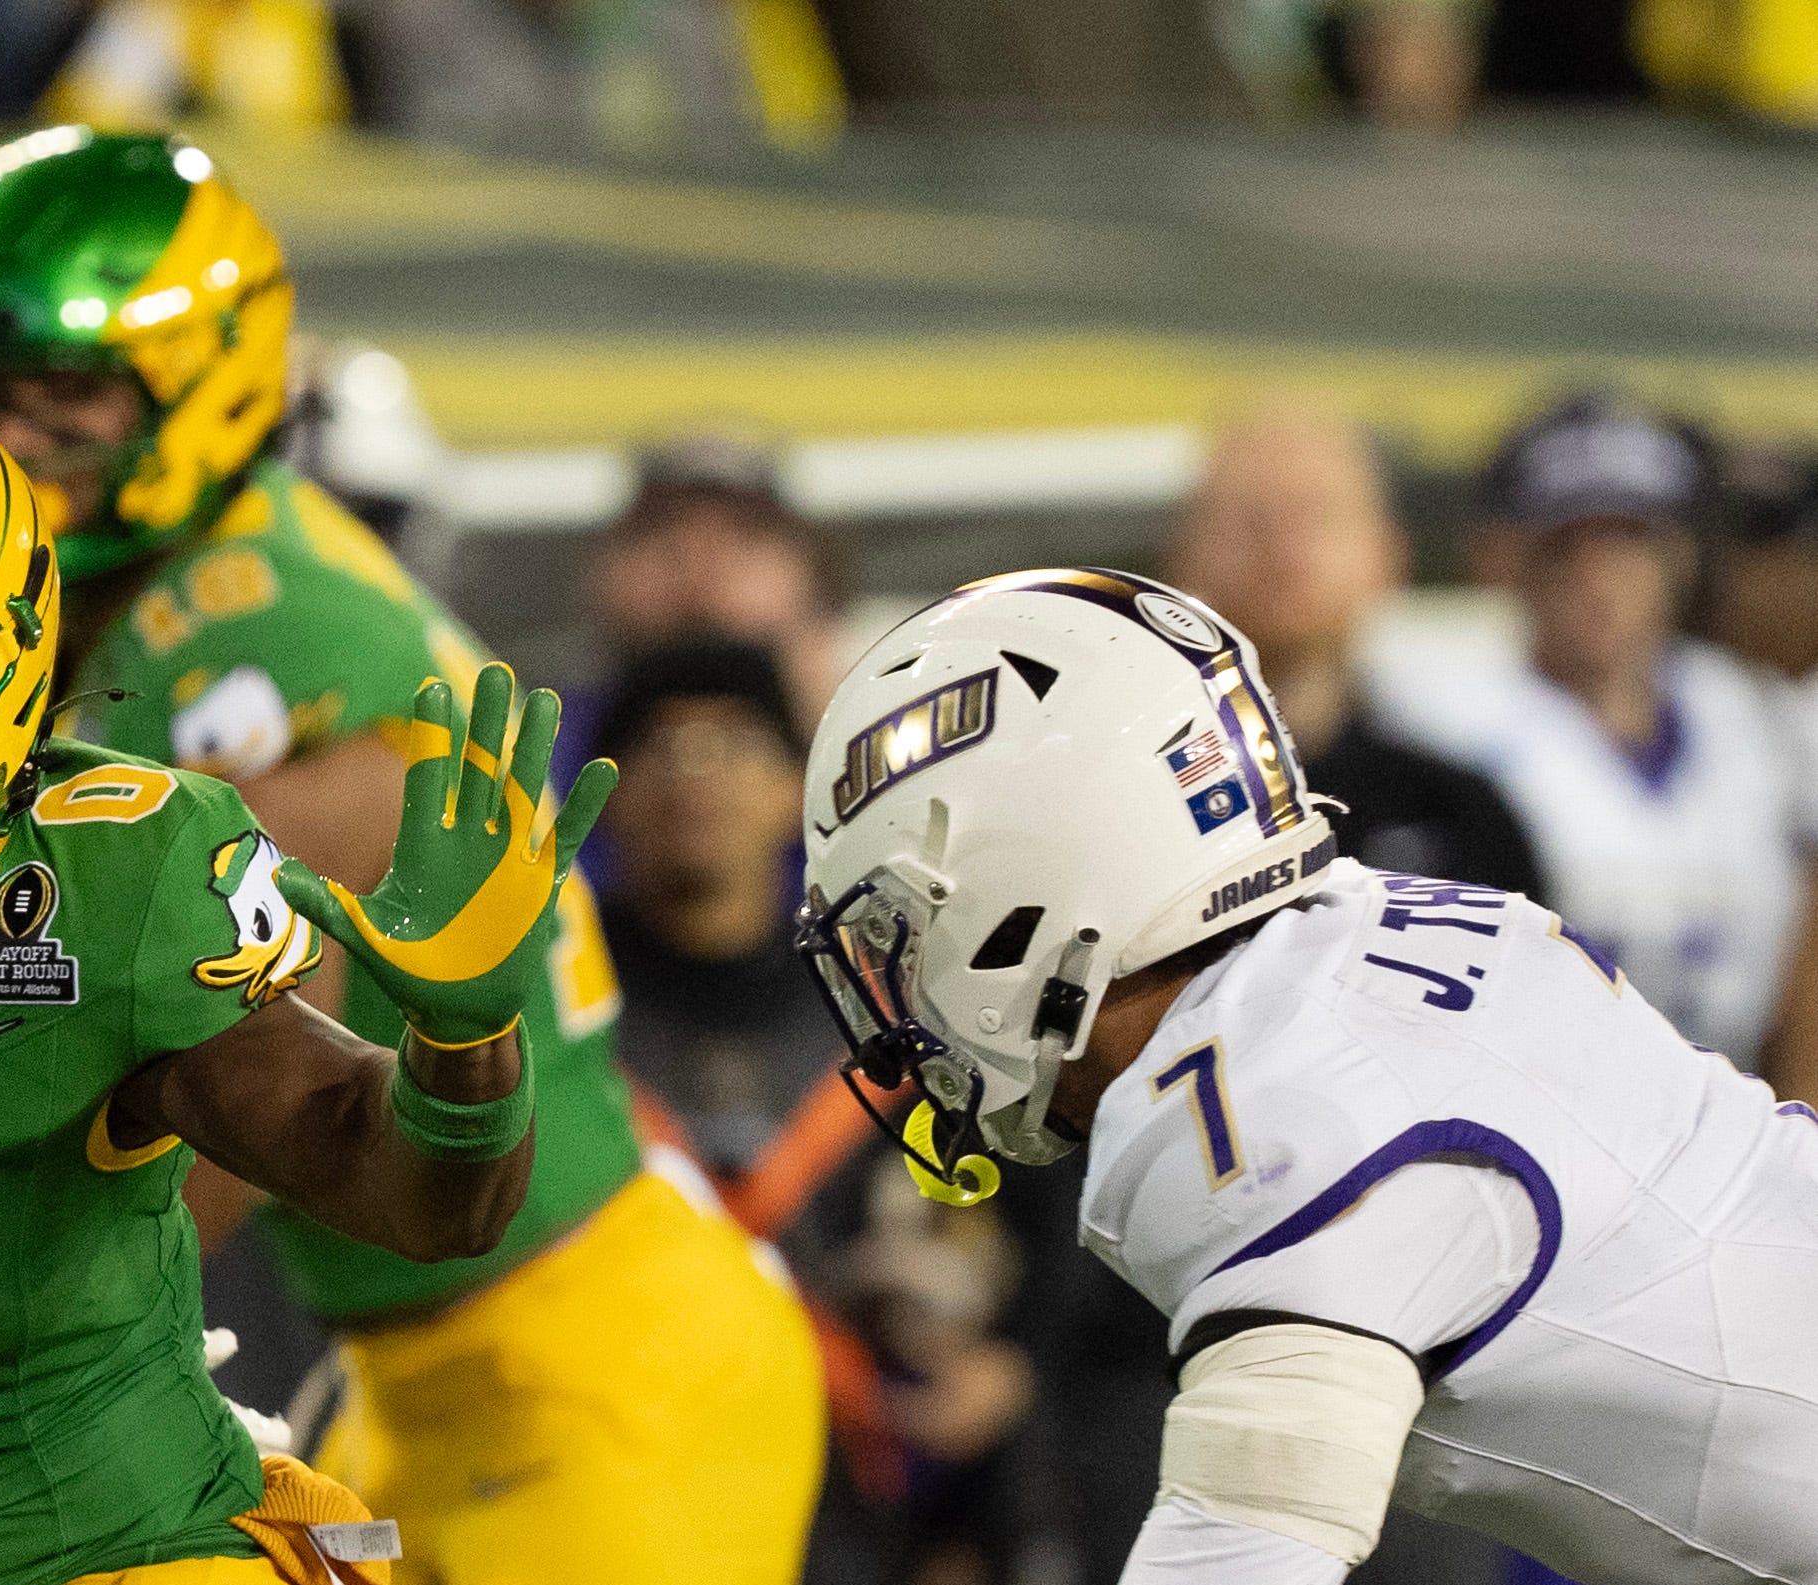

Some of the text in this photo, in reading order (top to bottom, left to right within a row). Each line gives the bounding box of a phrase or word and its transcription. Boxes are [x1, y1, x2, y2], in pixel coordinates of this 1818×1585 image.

[833, 666, 1000, 826] JMU
[1202, 857, 1294, 923] JAMES
[12, 964, 70, 979] ROUND
[1364, 952, 1485, 1012] J.
[1148, 1034, 1246, 1194] 7
